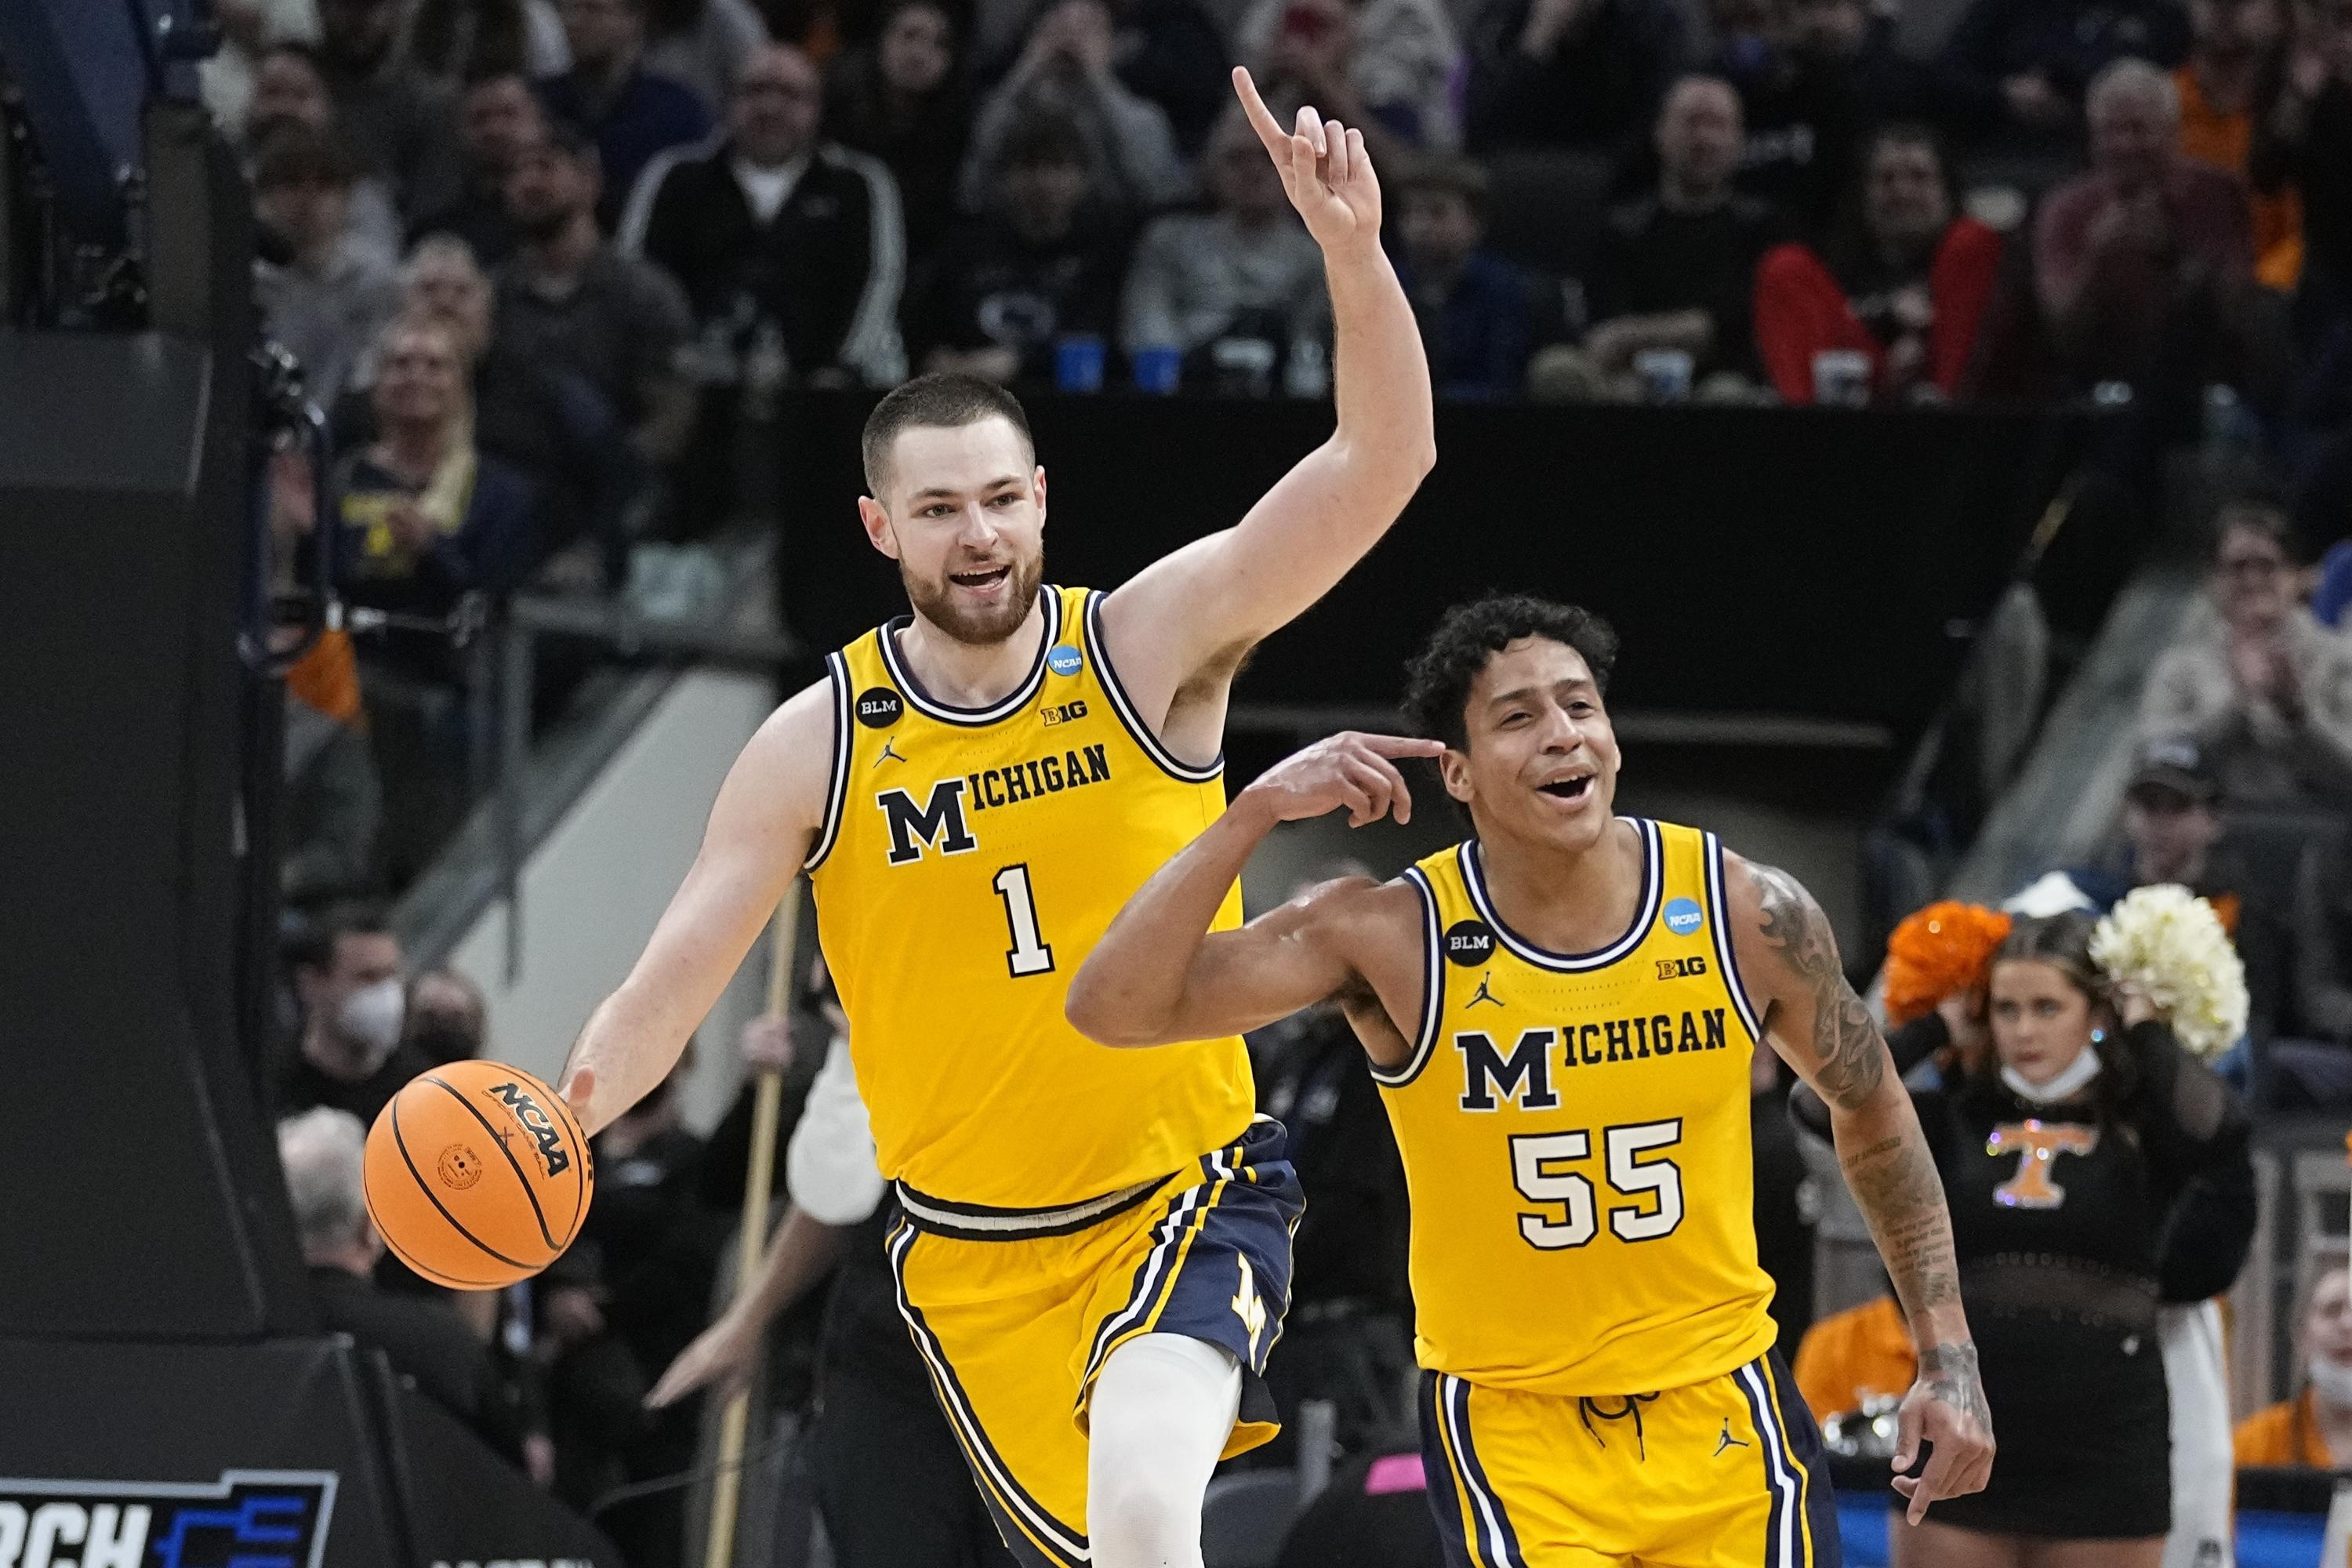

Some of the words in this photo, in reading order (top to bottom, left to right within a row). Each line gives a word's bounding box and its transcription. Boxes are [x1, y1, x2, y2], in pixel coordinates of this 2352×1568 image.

[861, 699, 898, 716] BLM
[875, 743, 1111, 867] MICHIGAN
[993, 862, 1055, 978] 1
[1450, 935, 1490, 951] BLM
[1669, 913, 1701, 927] NCAA
[1453, 1008, 1726, 1113] MICHIGAN
[488, 1082, 570, 1178] NCAA
[1987, 1120, 2100, 1208] T
[1508, 1117, 1683, 1251] 55
